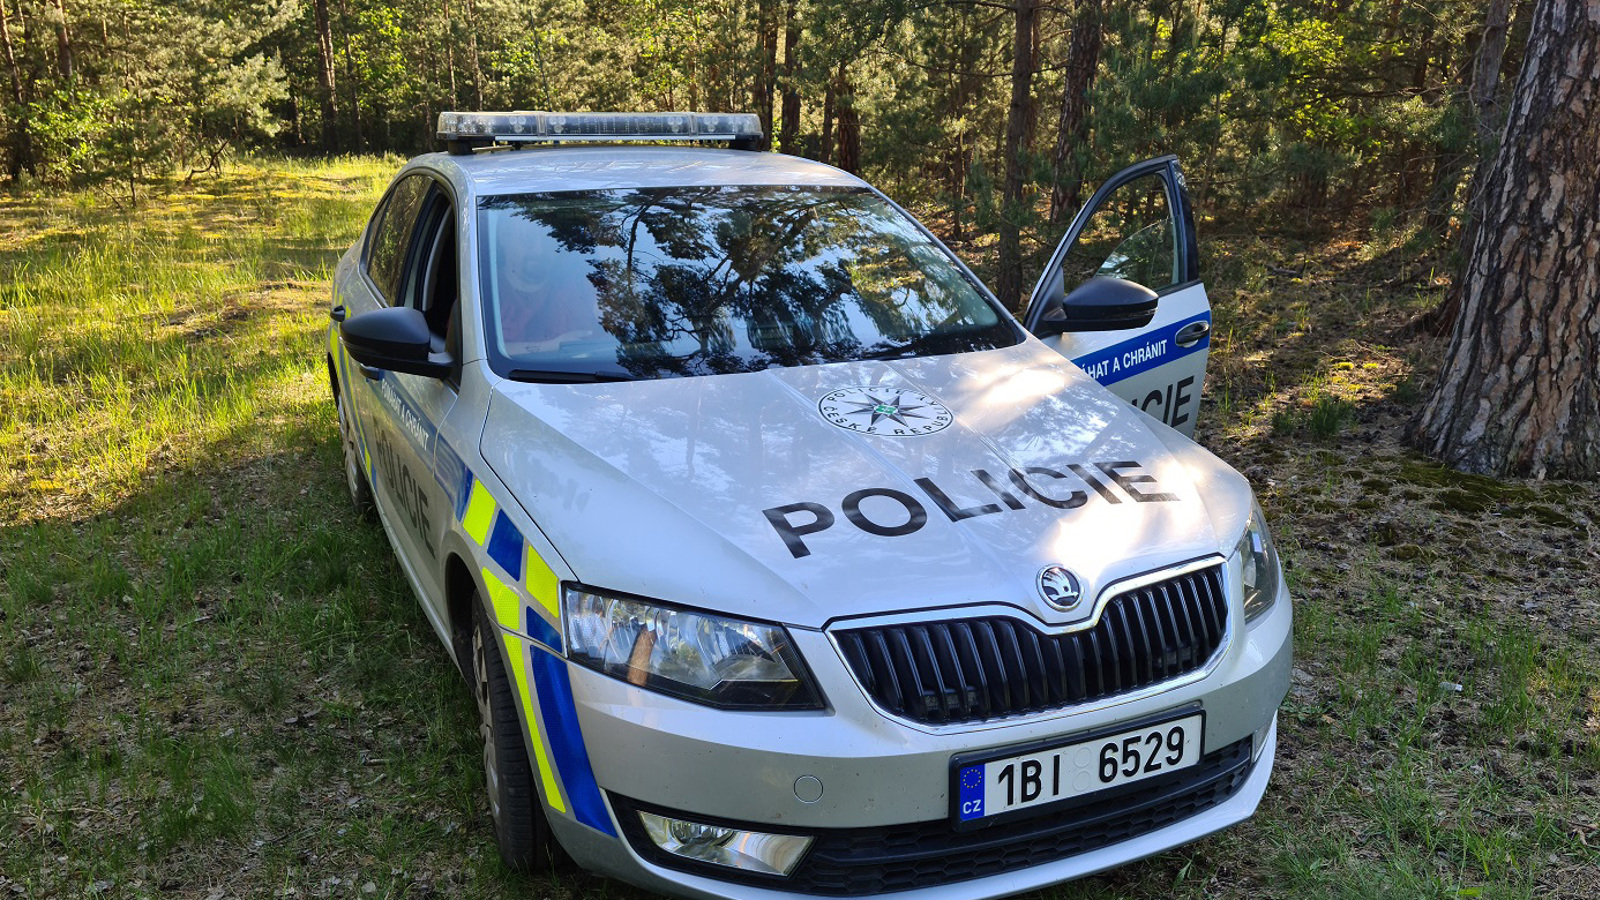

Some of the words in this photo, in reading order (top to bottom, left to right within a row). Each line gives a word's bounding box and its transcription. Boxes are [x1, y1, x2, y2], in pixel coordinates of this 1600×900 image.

[1112, 357, 1121, 373] A
[1122, 339, 1168, 369] CHRÁNIT
[405, 409, 430, 451] CHRÁNIT
[372, 413, 436, 560] POLICIE
[762, 460, 1181, 559] POLICIE
[997, 754, 1060, 806] 1BI
[1099, 726, 1185, 784] 6529
[962, 799, 982, 815] CZ
